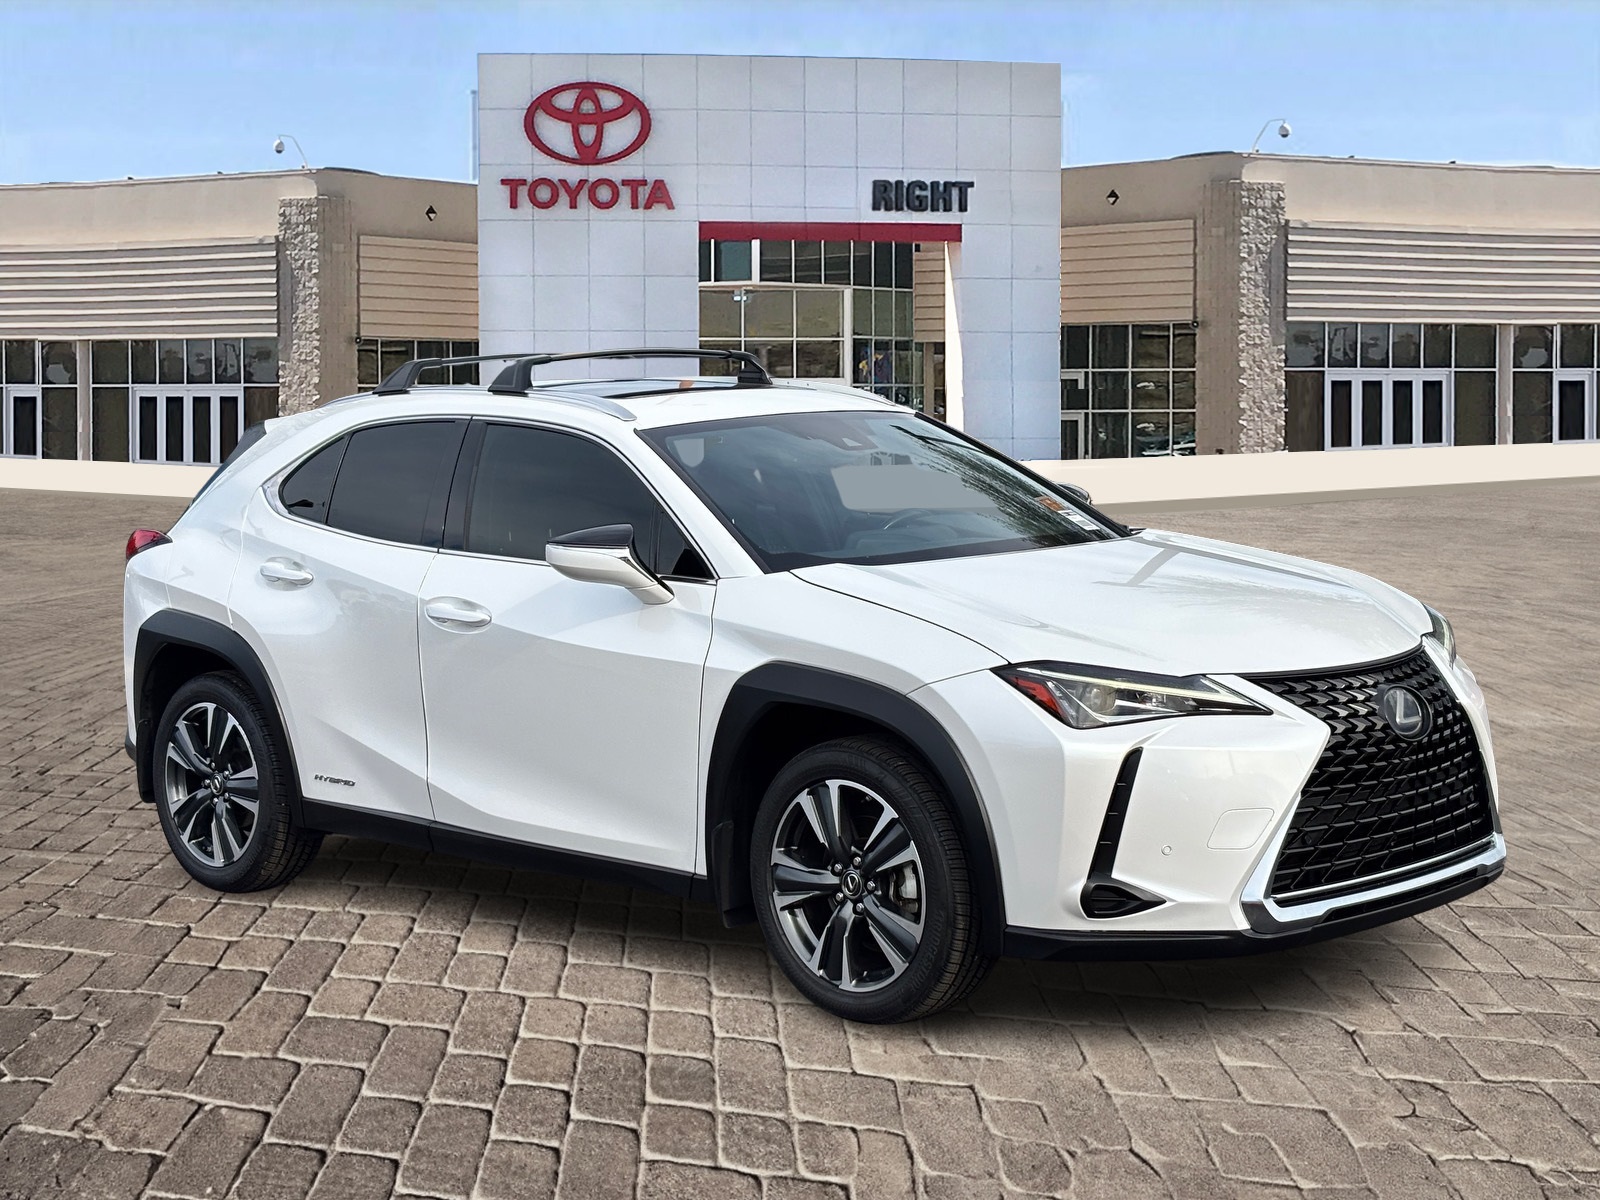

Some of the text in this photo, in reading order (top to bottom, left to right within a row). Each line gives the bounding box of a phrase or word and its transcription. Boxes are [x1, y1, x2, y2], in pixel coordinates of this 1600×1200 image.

[500, 177, 675, 210] TOYOTA
[871, 179, 975, 212] RIGHT
[314, 774, 356, 787] HYBRID
